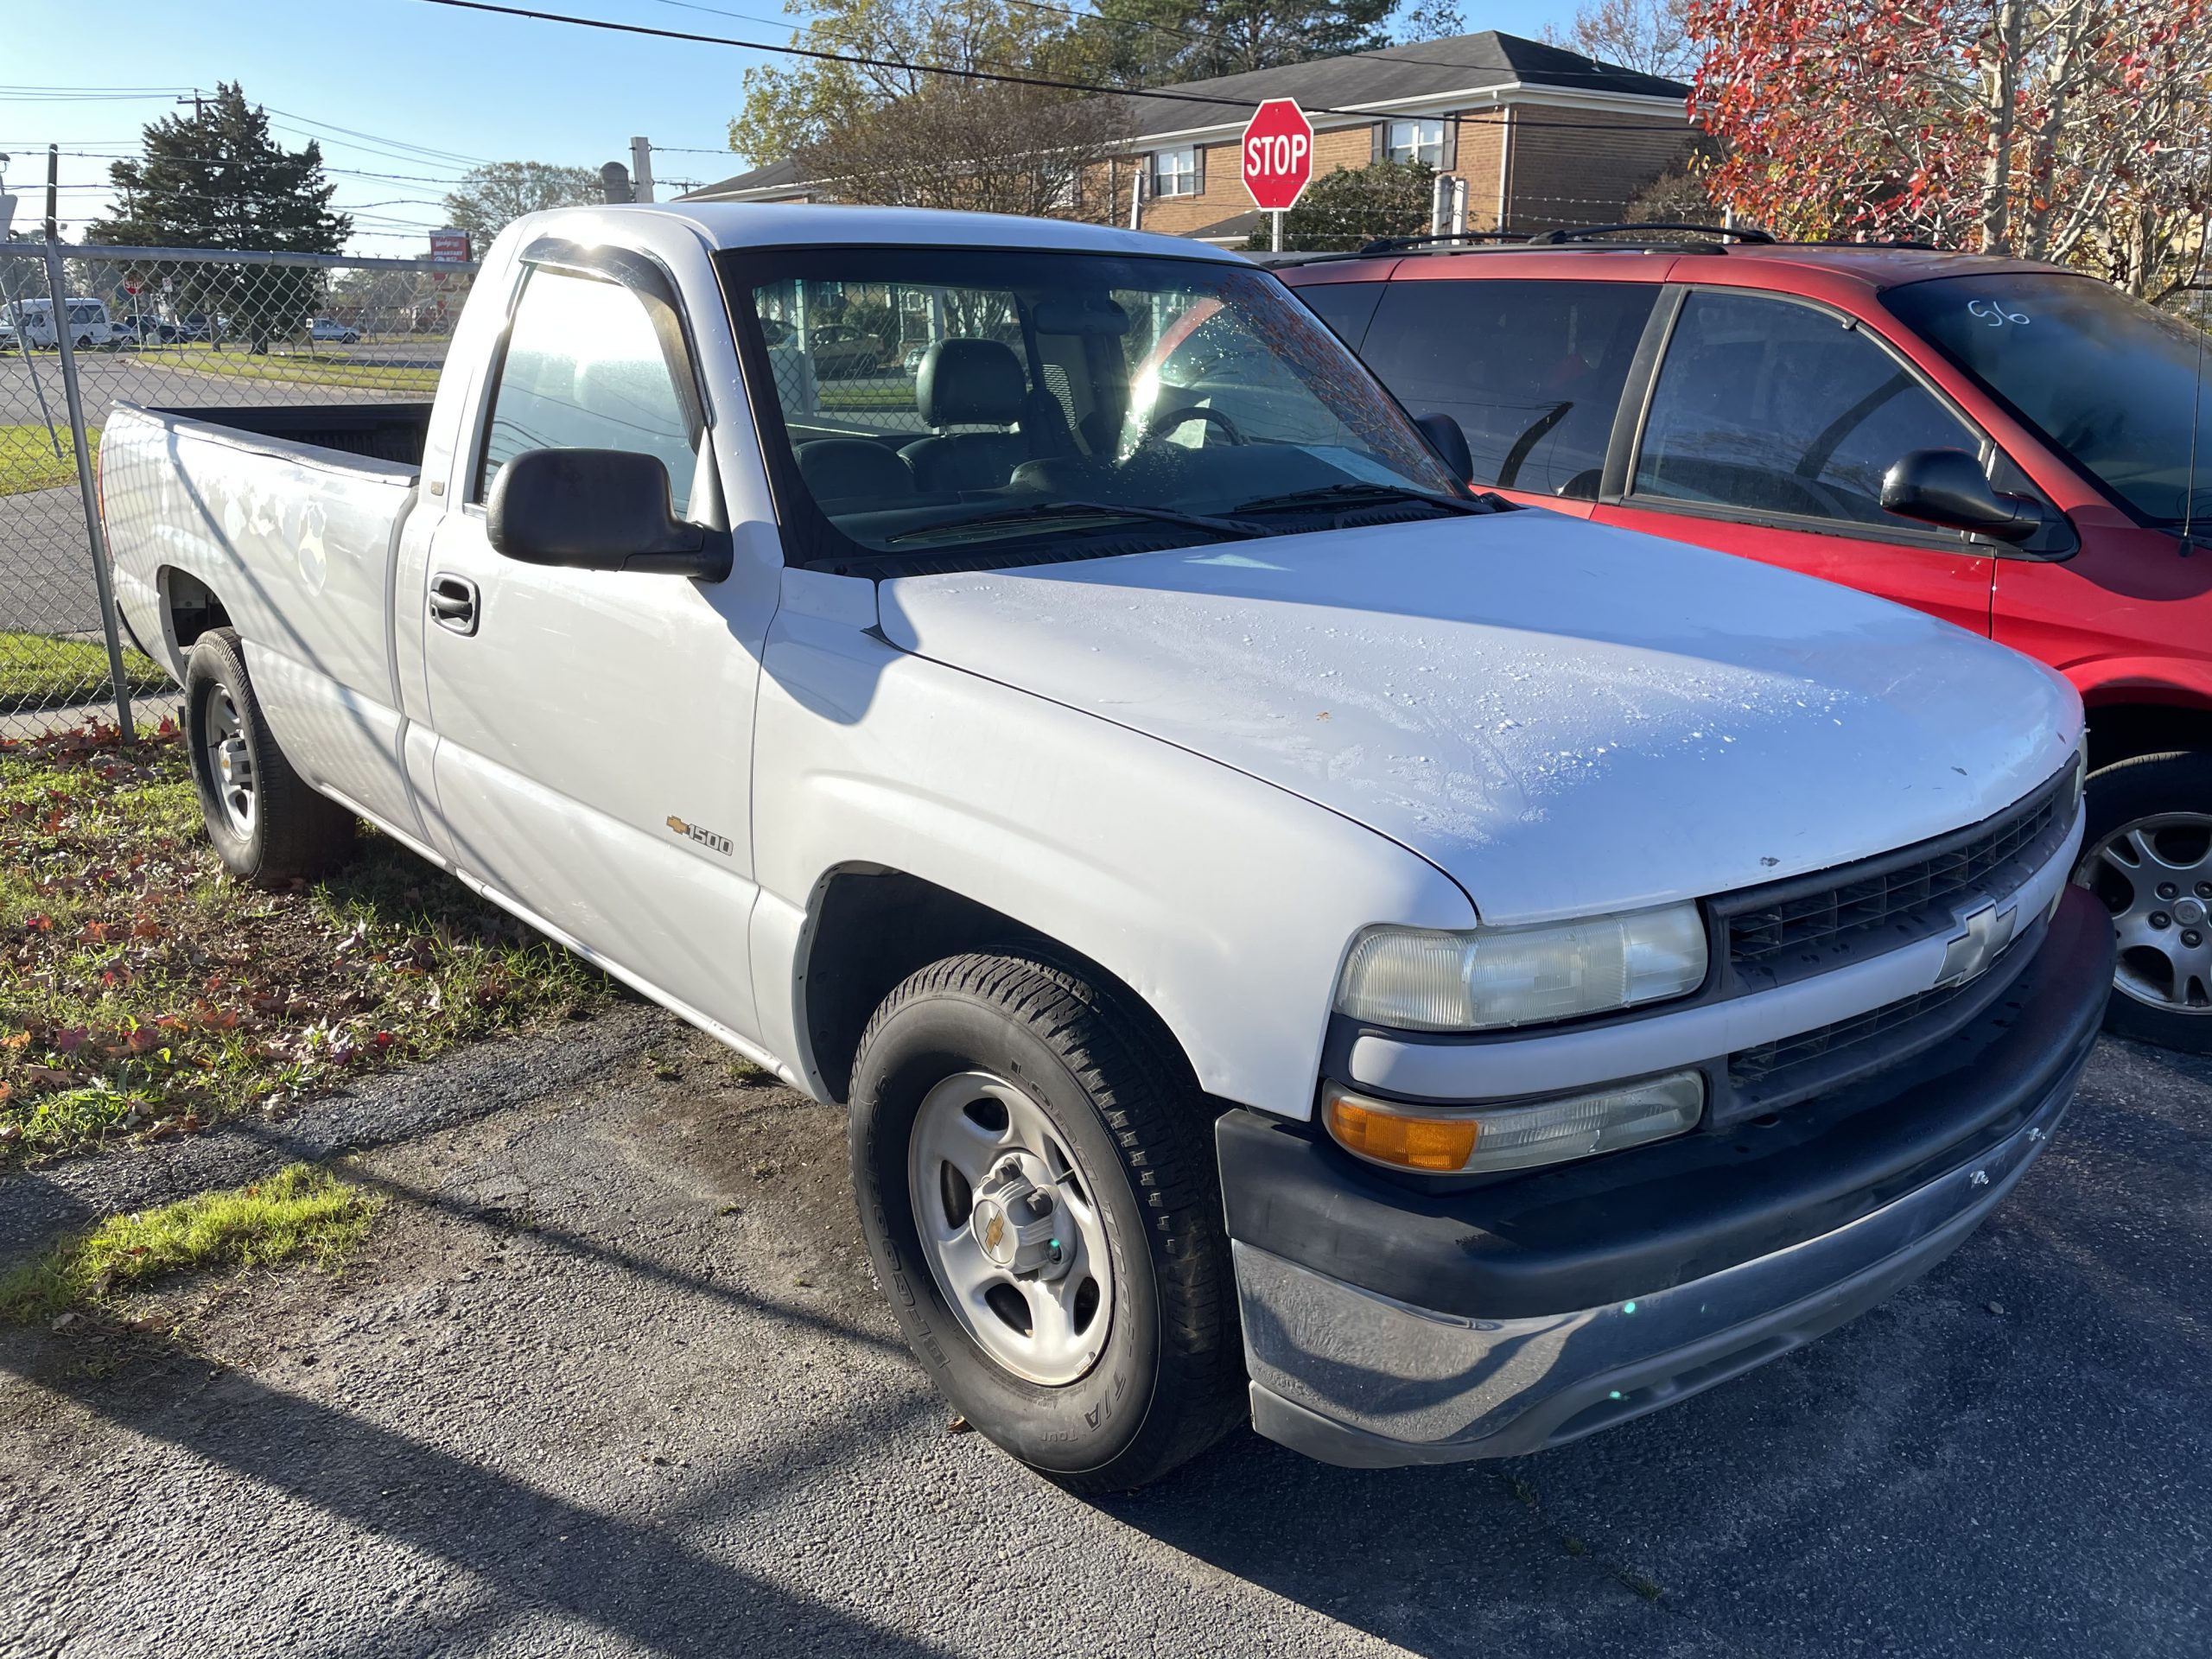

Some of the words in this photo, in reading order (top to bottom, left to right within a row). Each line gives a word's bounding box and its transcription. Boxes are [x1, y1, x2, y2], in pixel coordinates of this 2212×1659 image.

[1247, 134, 1307, 176] STOP
[1967, 300, 2031, 327] 56
[688, 823, 734, 857] 1500
[1084, 1368, 1127, 1432] T/A
